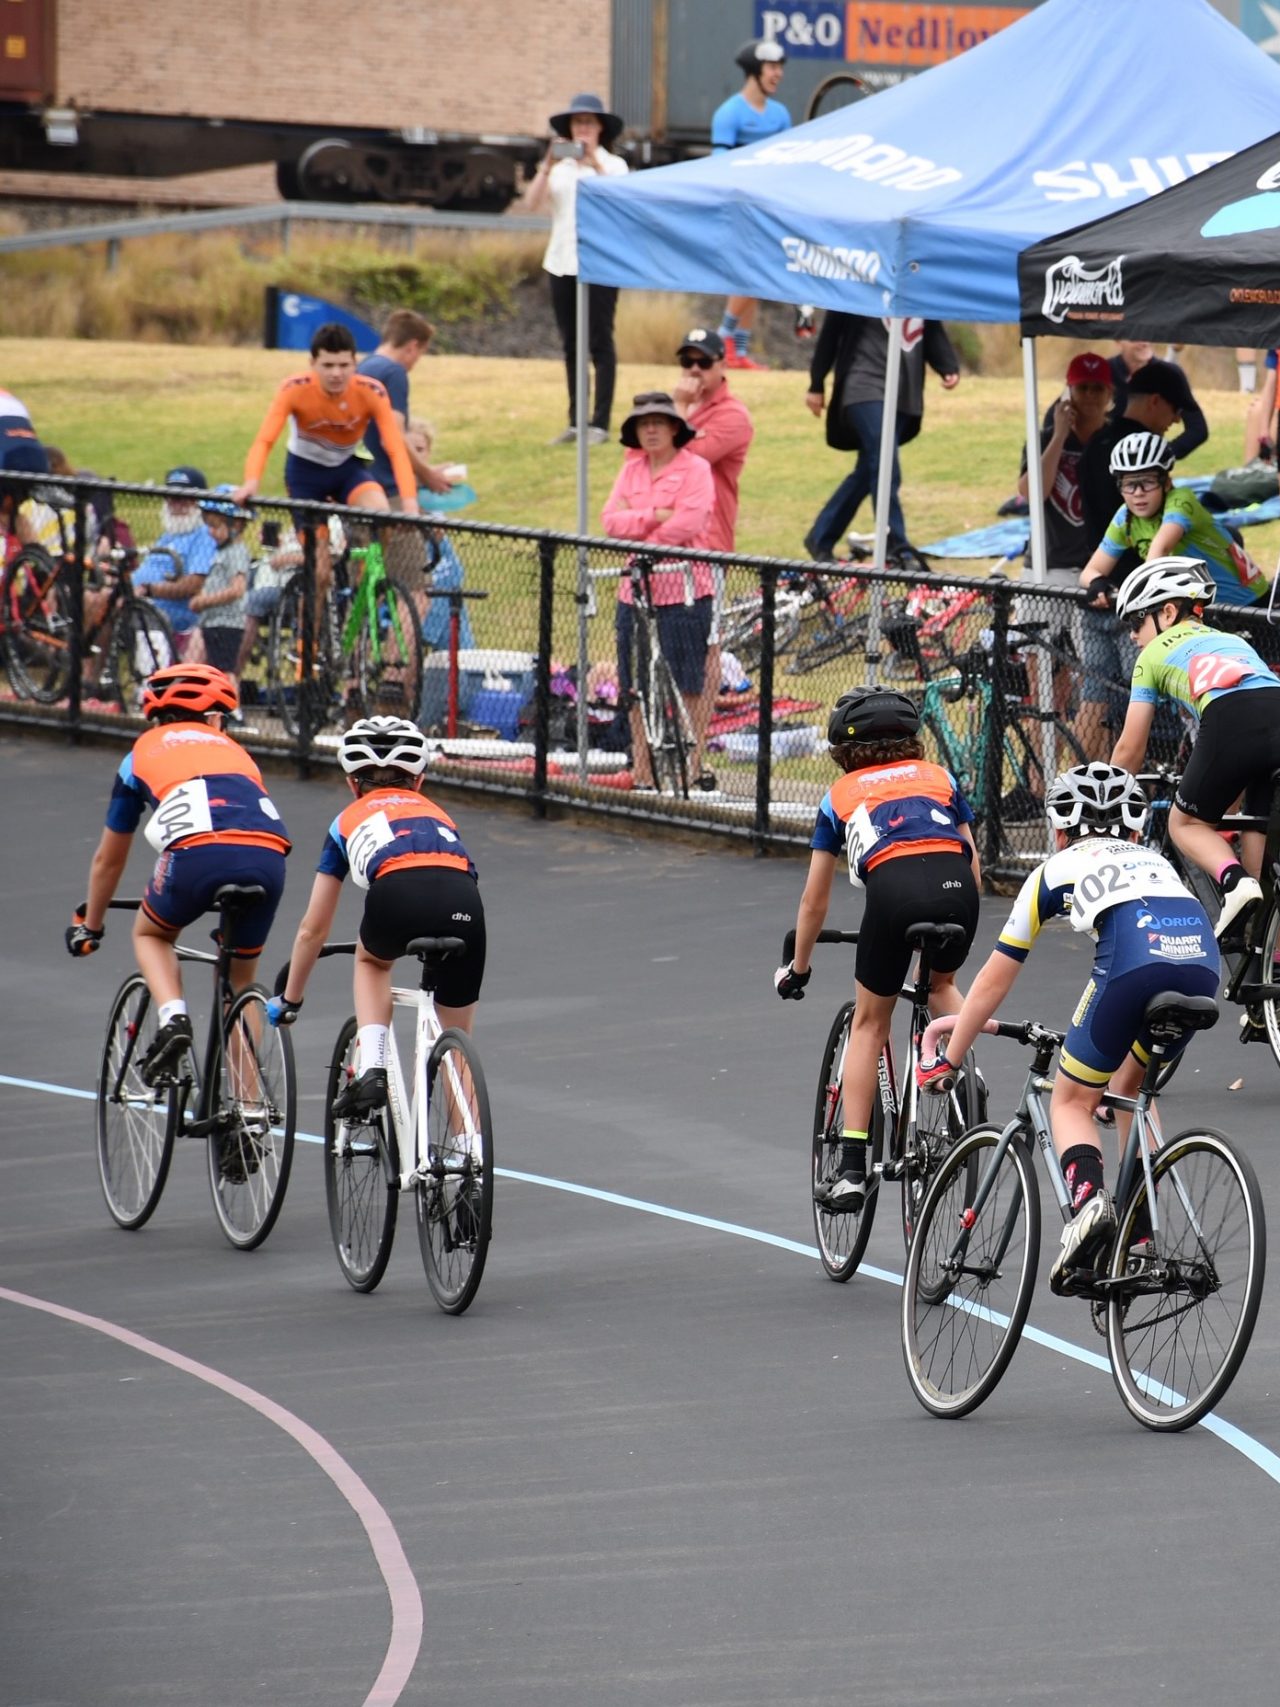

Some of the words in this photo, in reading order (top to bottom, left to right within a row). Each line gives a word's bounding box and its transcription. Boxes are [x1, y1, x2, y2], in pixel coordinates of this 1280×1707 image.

[761, 11, 842, 47] P&O
[731, 133, 964, 191] SHIMANO
[780, 236, 882, 285] SHIMANO
[1193, 655, 1240, 693] 27
[157, 788, 195, 842] 104
[943, 880, 962, 889] dhb
[1073, 864, 1131, 918] 102
[452, 912, 471, 921] dhb
[1161, 916, 1203, 927] ORICA
[1159, 933, 1202, 945] QUARRY
[1161, 943, 1201, 956] MINING
